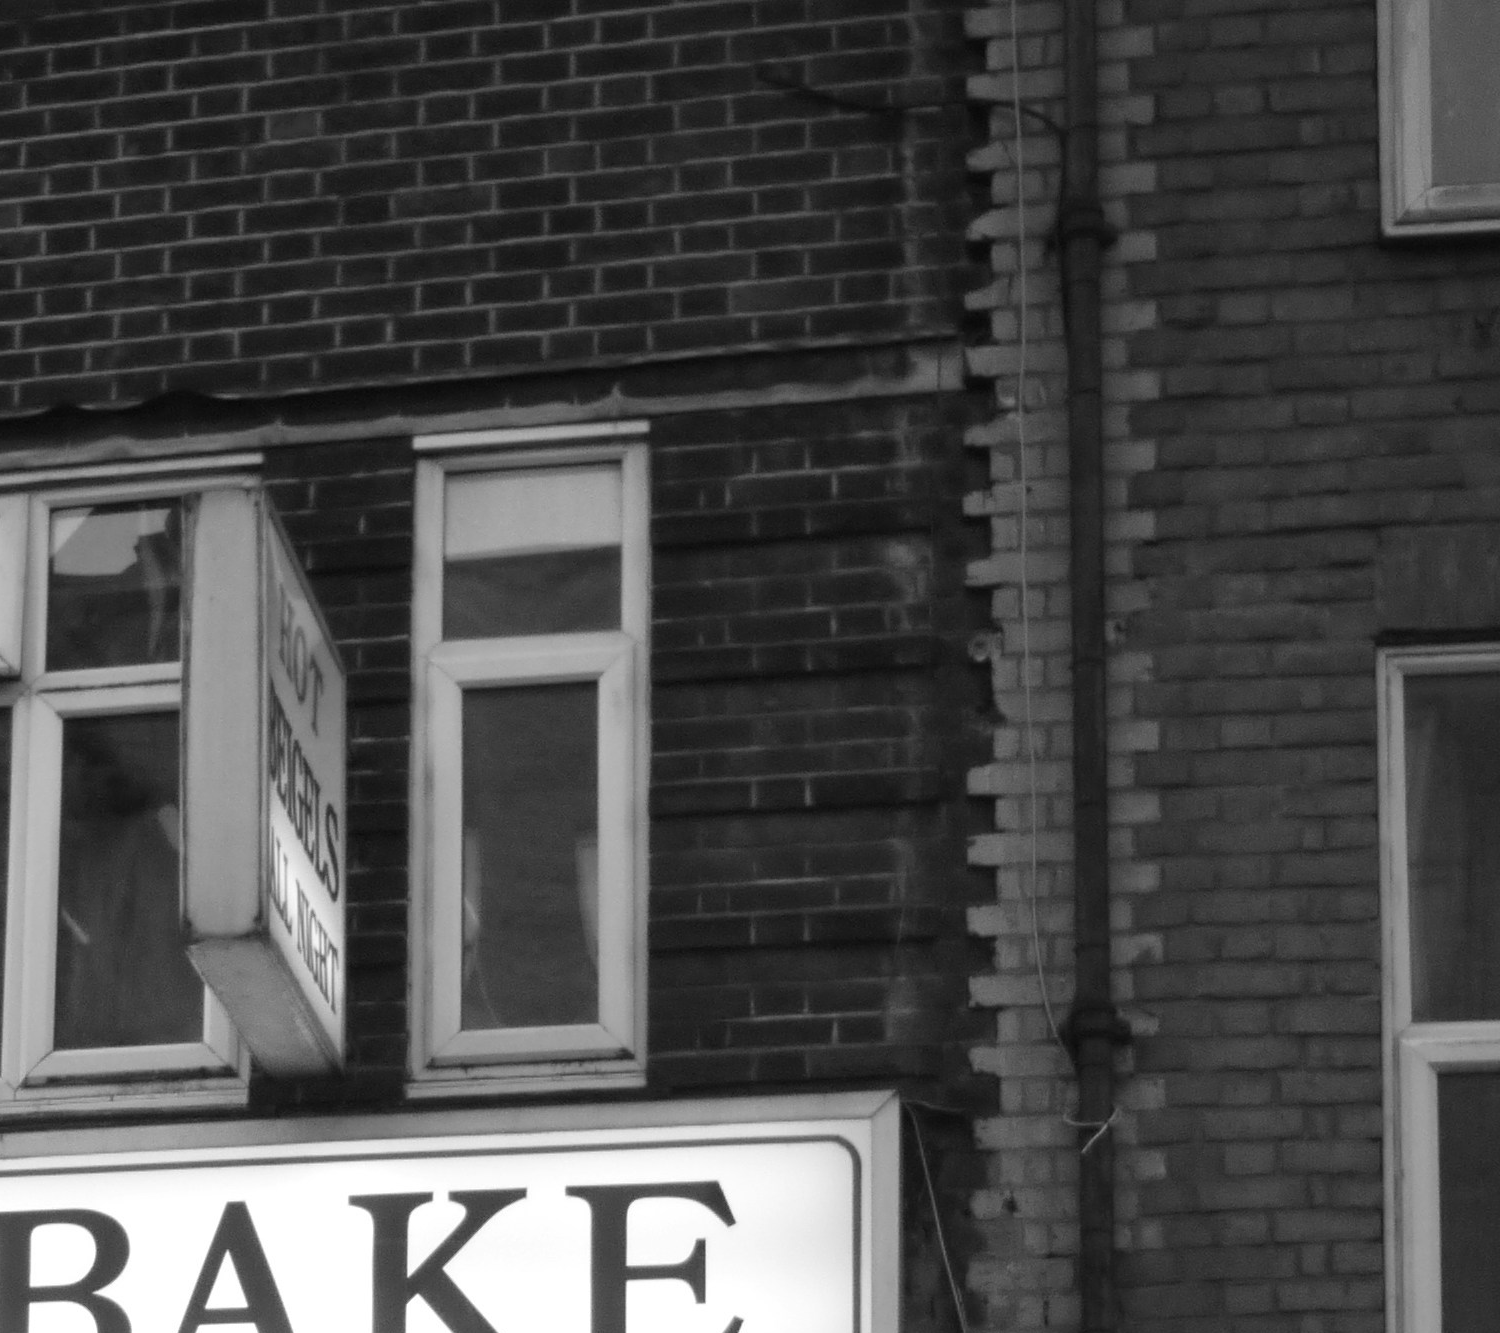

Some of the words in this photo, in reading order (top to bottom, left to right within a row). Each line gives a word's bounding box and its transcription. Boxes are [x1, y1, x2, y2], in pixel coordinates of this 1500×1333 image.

[279, 582, 324, 738] HOT
[269, 676, 339, 903] BEIGELS
[269, 825, 293, 937] ALL
[295, 878, 338, 1016] NIGHT
